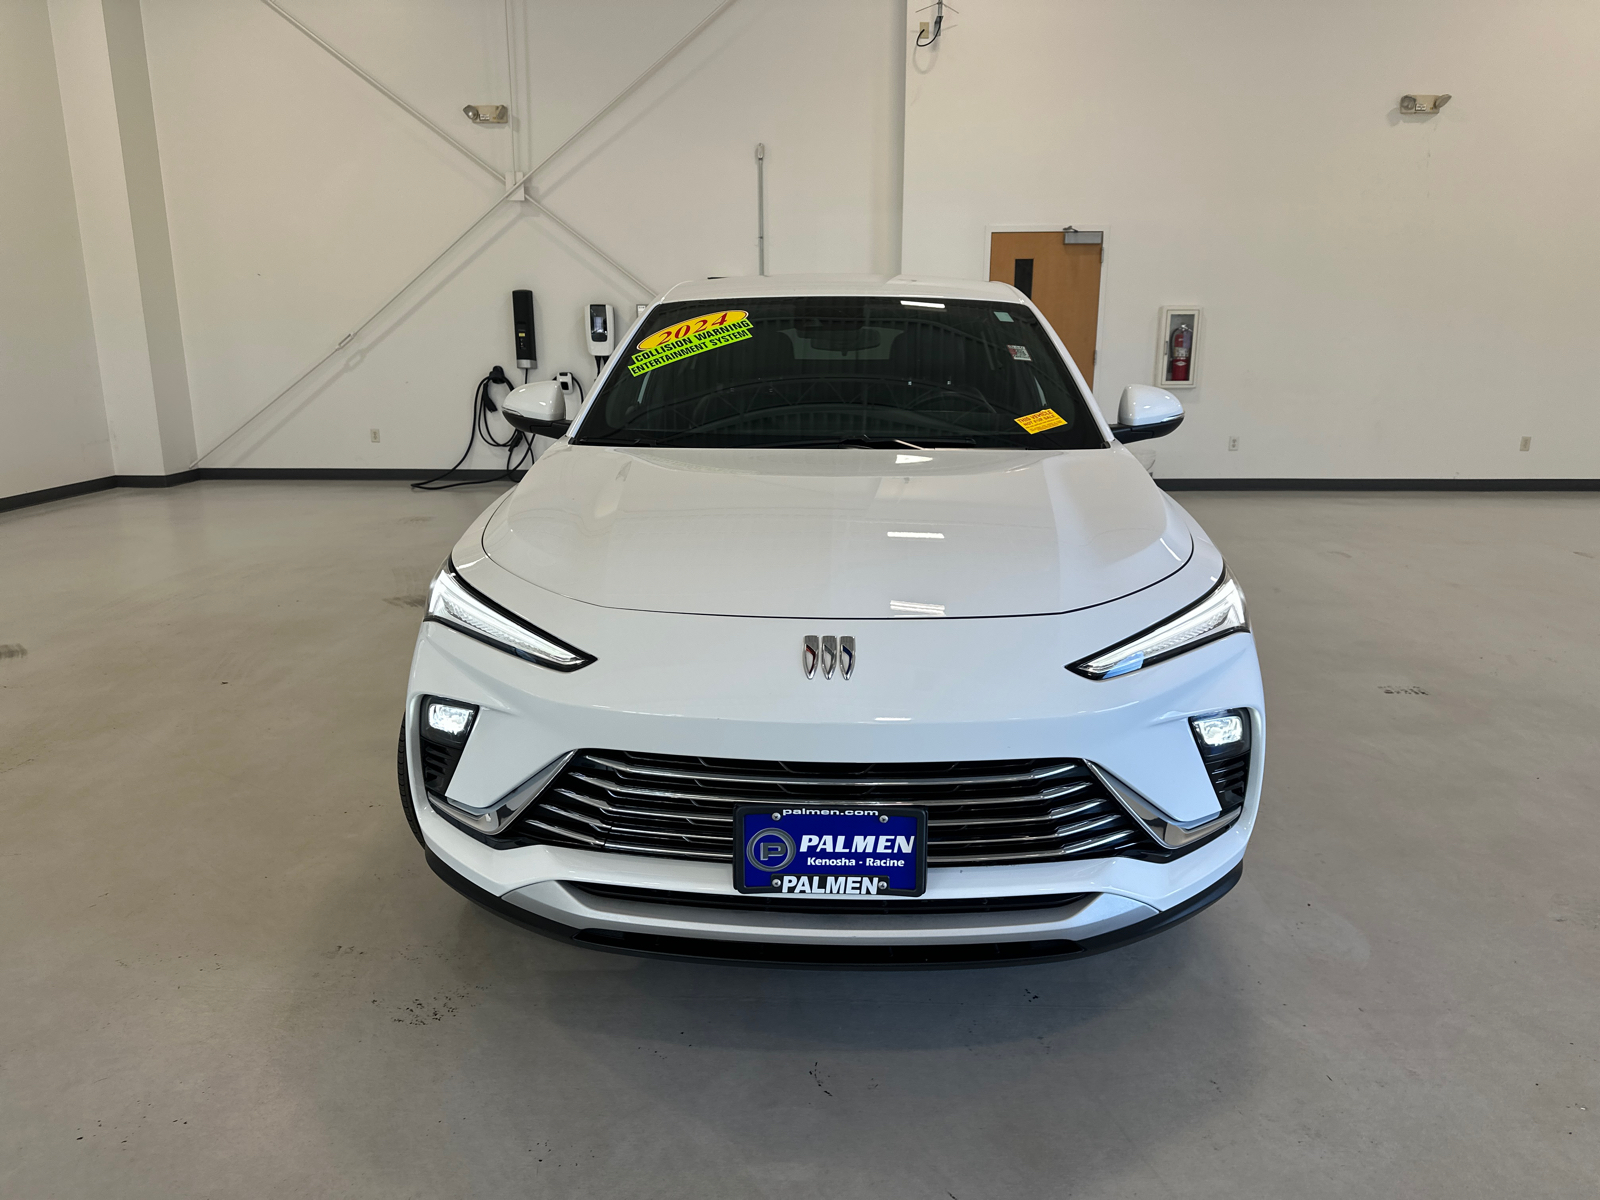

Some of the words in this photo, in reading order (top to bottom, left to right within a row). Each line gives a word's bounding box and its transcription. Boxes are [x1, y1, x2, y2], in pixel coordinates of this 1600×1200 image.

[657, 313, 728, 346] 2024
[634, 336, 692, 363] COLLISION
[694, 320, 750, 342] WARNING
[631, 342, 708, 375] ENTERTAINMENT
[711, 329, 748, 346] SYSTEM
[782, 808, 879, 816] palmen.com
[799, 835, 915, 854] PALMEN
[807, 857, 856, 866] Kenosha
[866, 857, 905, 867] Racine
[781, 875, 879, 895] PALMEN
